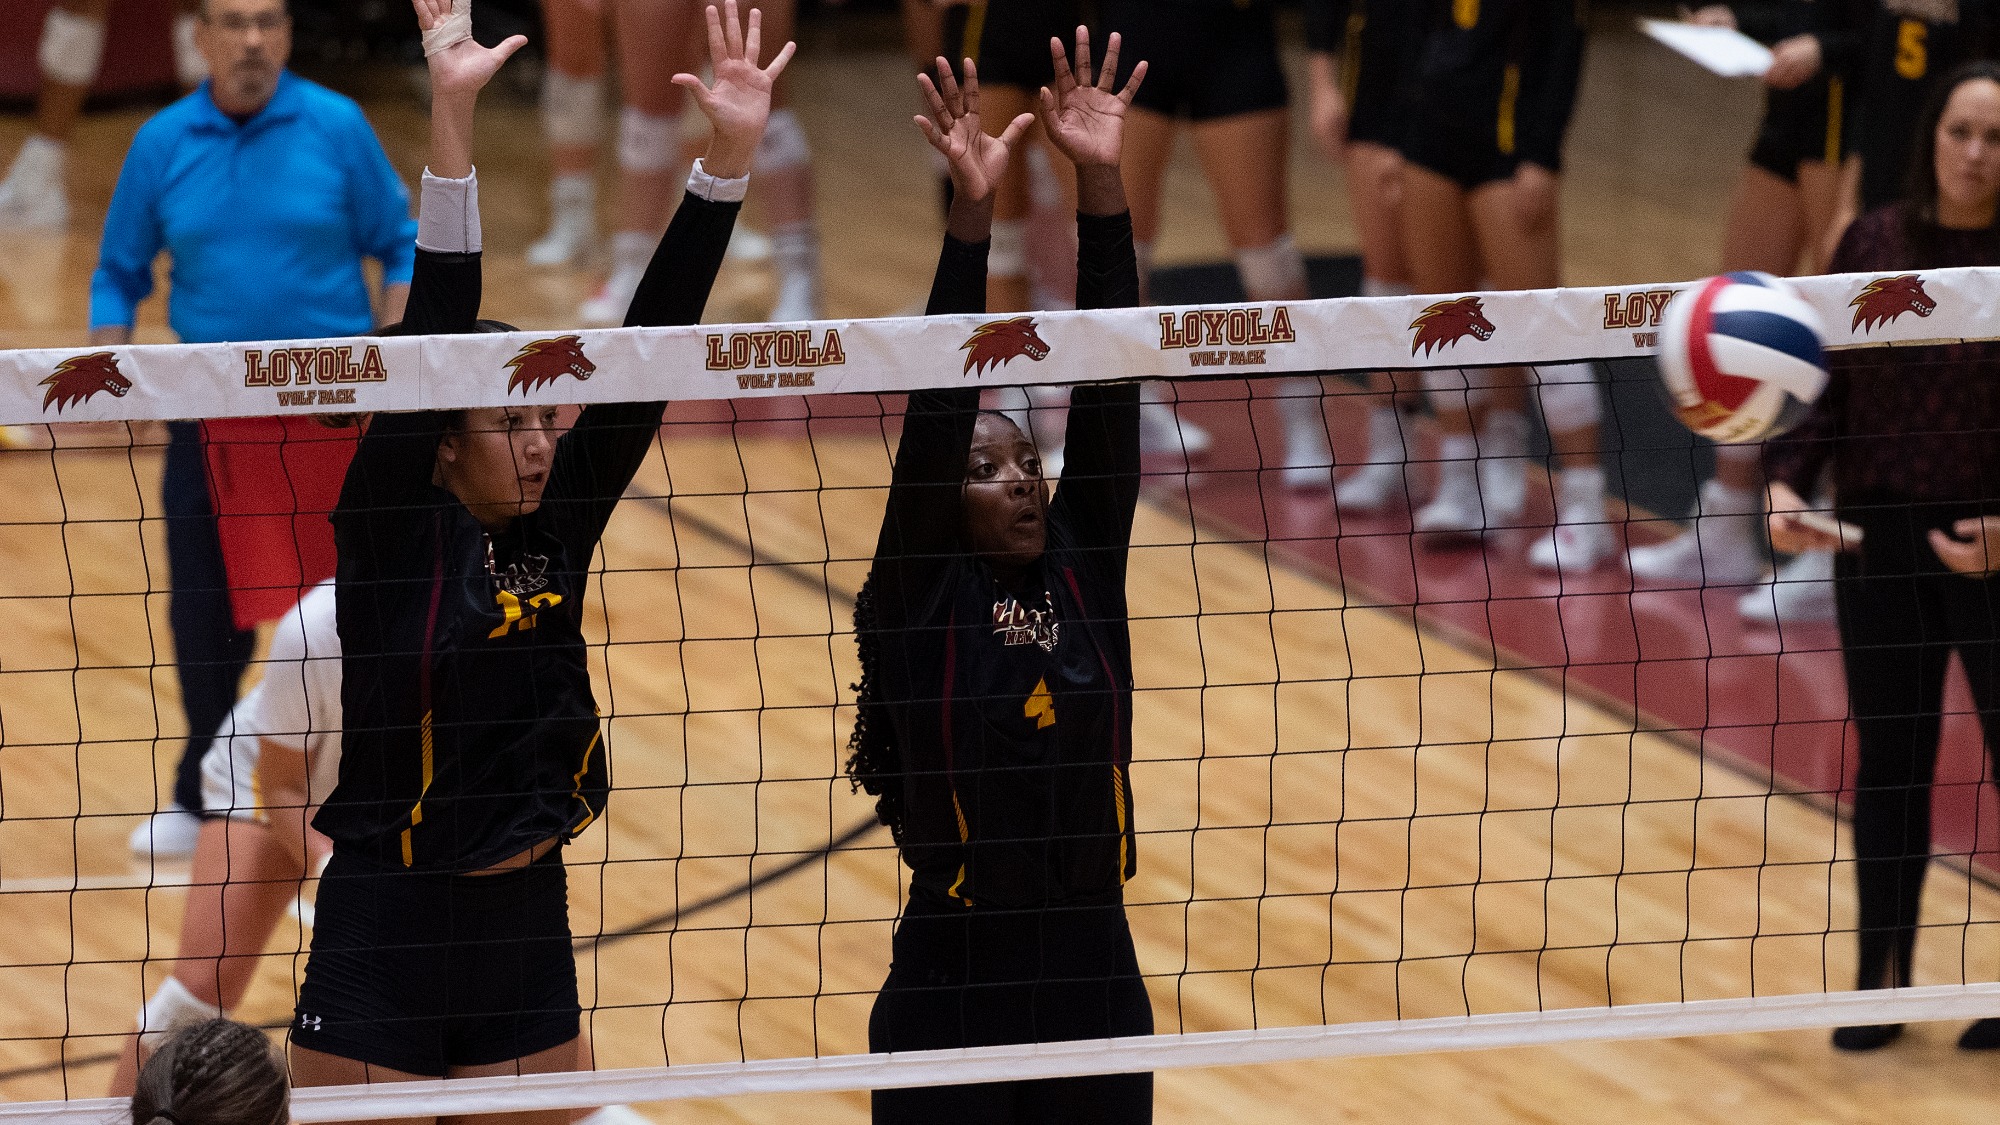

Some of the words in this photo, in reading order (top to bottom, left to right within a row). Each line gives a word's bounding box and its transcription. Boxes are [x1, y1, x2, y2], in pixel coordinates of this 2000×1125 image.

[1894, 20, 1928, 79] 5
[1159, 306, 1296, 349] LOYOLA
[1604, 290, 1683, 329] LOY
[706, 328, 846, 370] LOYOLA
[1189, 351, 1228, 367] WOLF
[1229, 350, 1266, 365] PACK
[1632, 332, 1660, 348] WO
[245, 345, 387, 387] LOYOLA
[737, 373, 777, 389] WOLF
[778, 372, 815, 388] PACK
[277, 390, 317, 406] WOLF
[318, 388, 356, 405] PACK
[1024, 674, 1056, 729] 4
